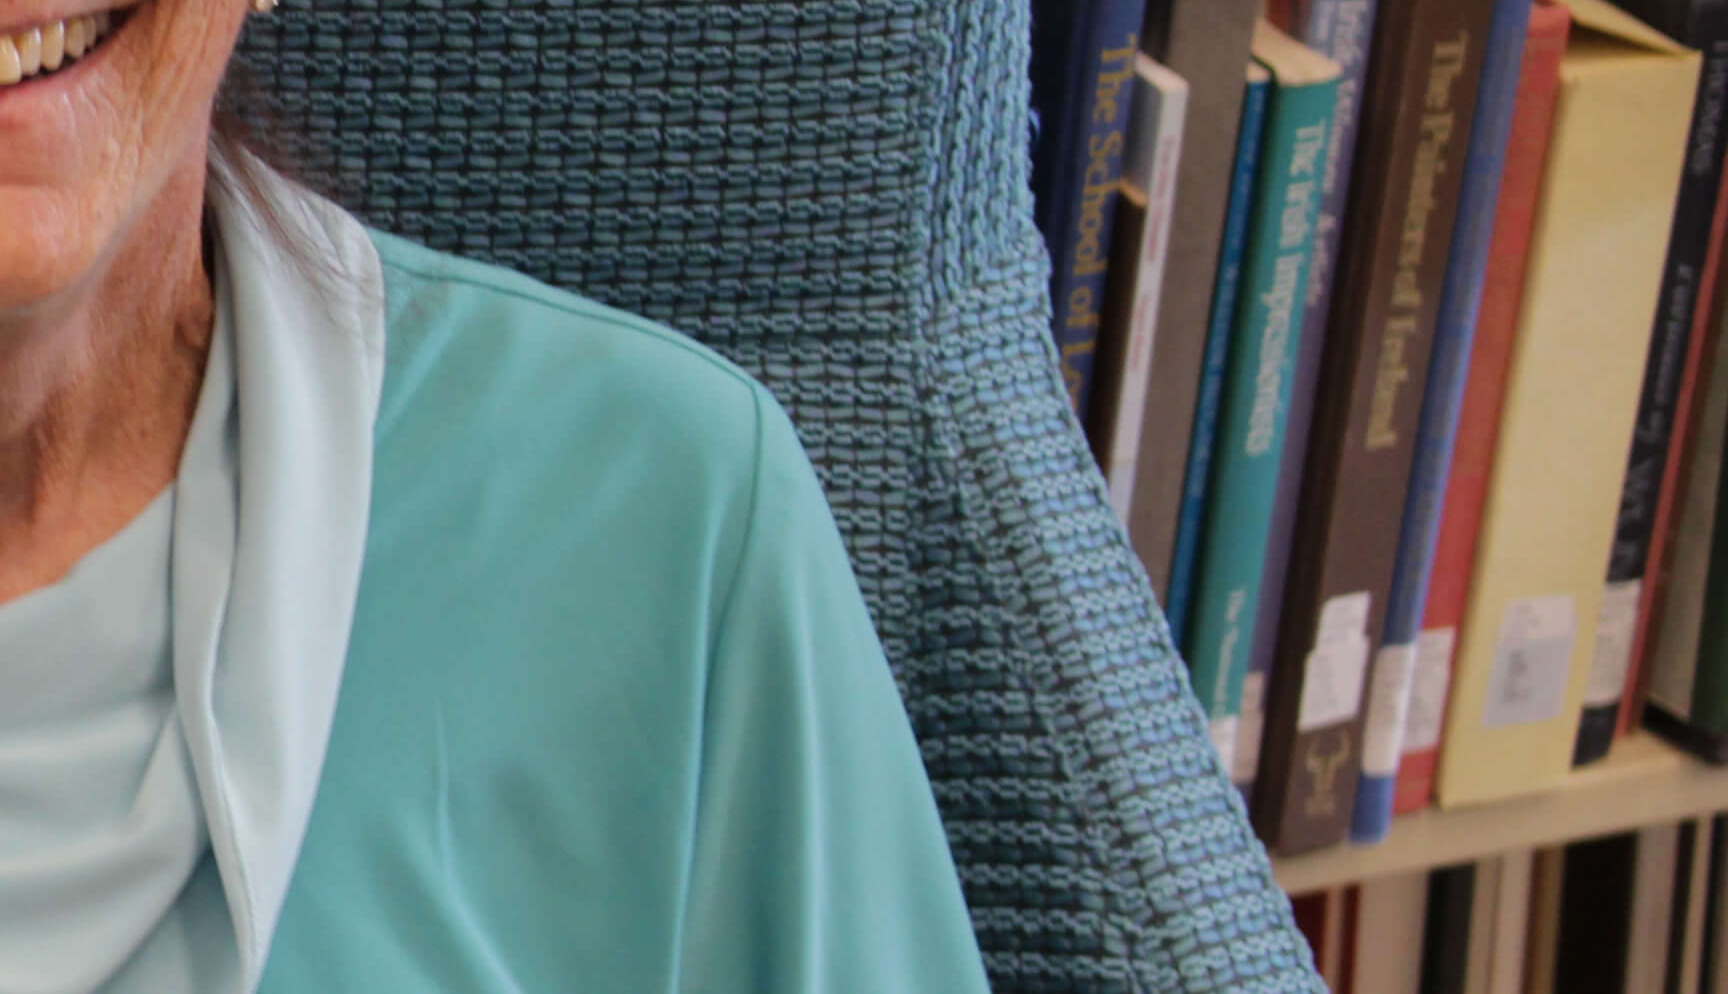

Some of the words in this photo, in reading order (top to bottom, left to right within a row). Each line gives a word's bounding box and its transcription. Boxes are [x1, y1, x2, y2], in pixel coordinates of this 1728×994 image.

[1096, 32, 1136, 124] The
[1422, 29, 1471, 109] The
[1287, 118, 1329, 177] The
[1069, 128, 1124, 278] School
[1278, 180, 1317, 247] Irish
[1397, 110, 1455, 267] Painters
[1067, 284, 1099, 331] of
